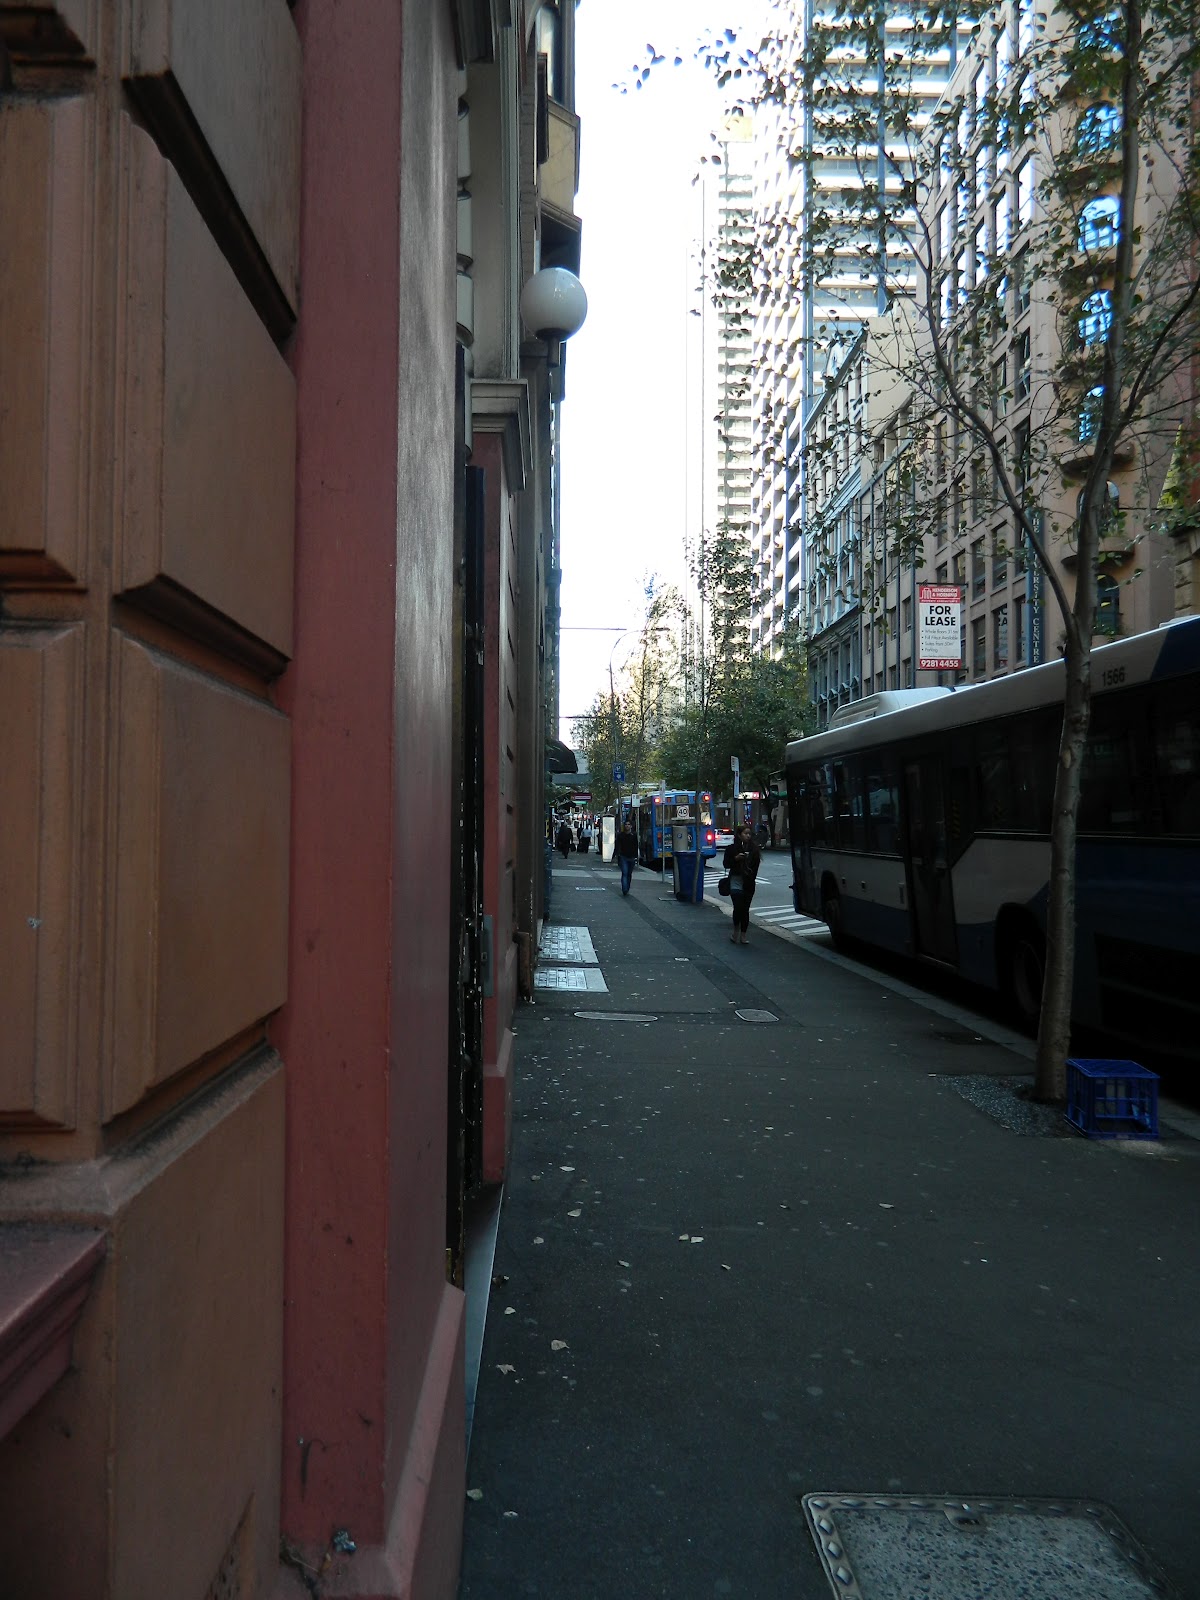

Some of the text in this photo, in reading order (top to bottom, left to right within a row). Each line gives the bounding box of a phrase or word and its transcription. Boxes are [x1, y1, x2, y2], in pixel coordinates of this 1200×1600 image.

[929, 605, 951, 615] FOR
[925, 616, 956, 626] LEASE
[1032, 617, 1040, 663] CENTRE
[921, 659, 959, 667] 9281 4455
[1102, 666, 1125, 687] 1566
